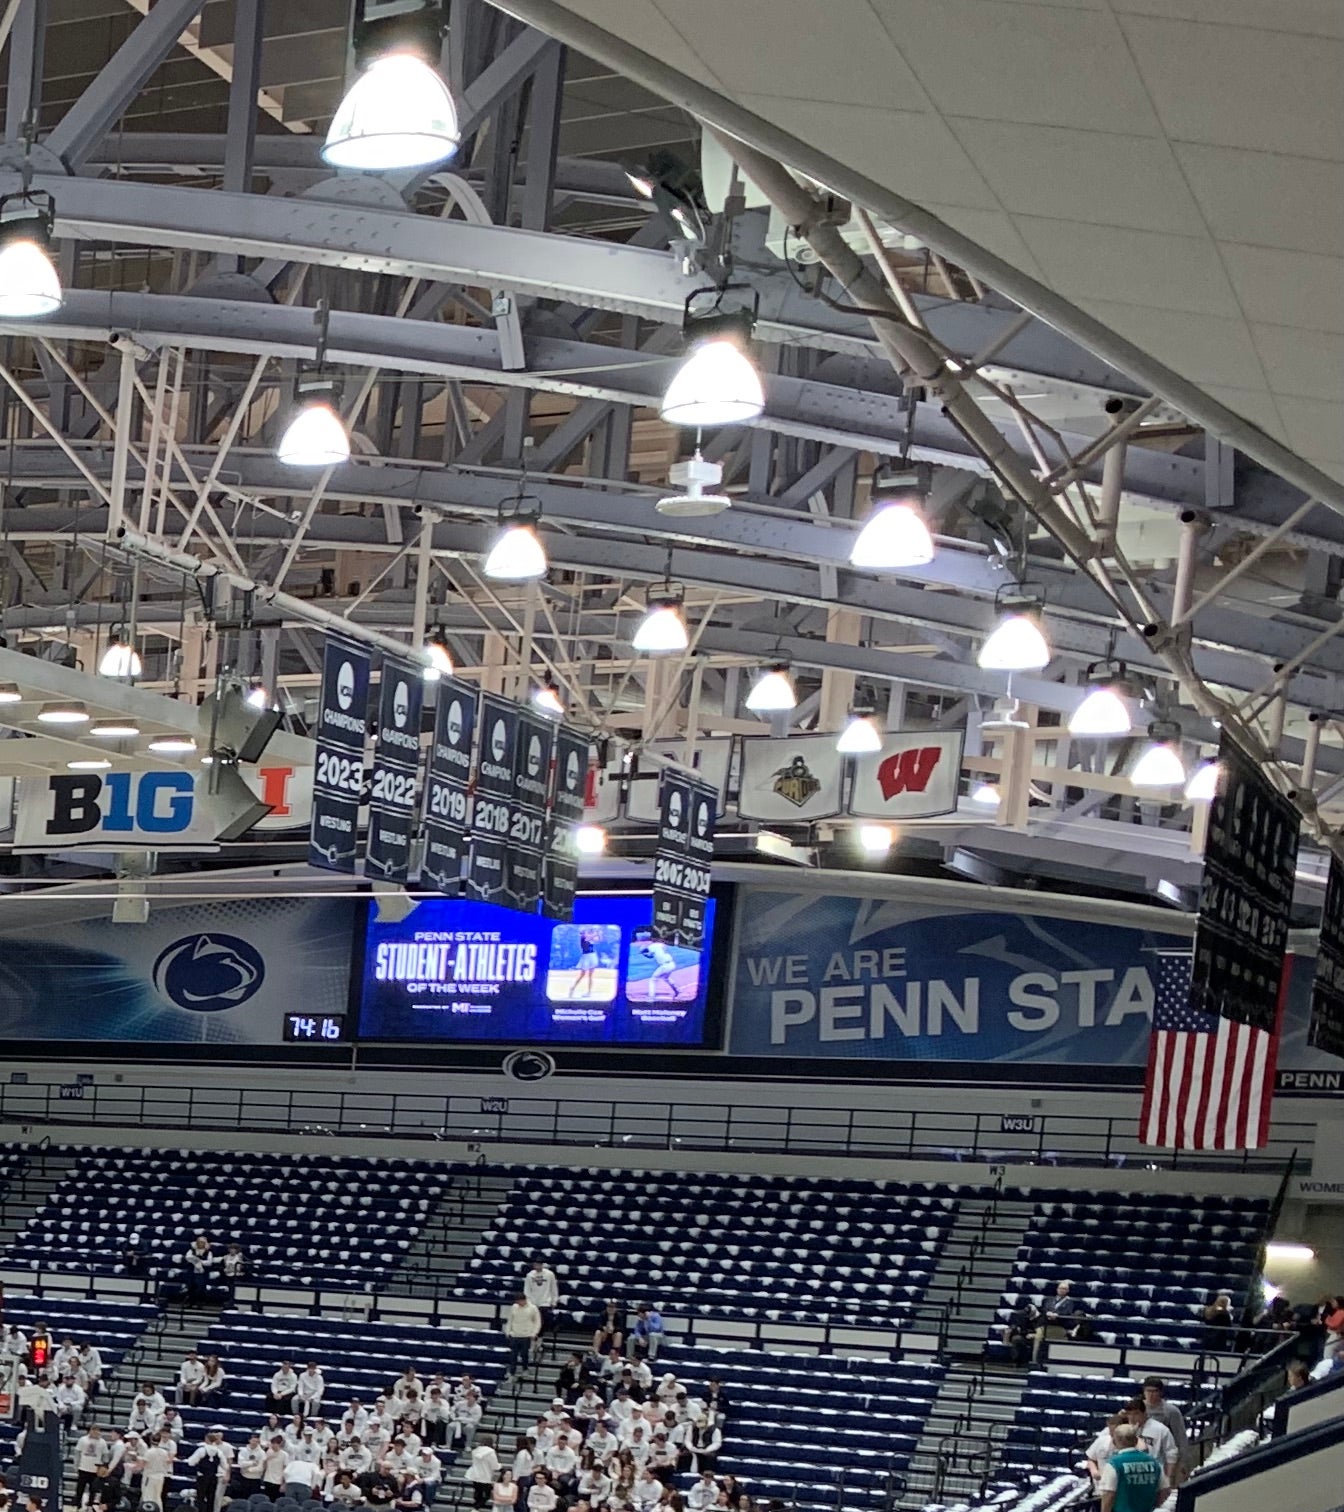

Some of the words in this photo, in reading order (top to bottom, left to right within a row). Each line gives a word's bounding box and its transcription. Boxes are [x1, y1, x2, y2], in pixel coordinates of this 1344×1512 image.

[317, 752, 363, 791] 2023
[372, 769, 415, 805] 2022
[877, 747, 942, 802] W
[432, 785, 466, 820] 2019
[475, 802, 509, 833] 2018
[511, 813, 542, 844] 2017
[415, 932, 453, 941] PENN
[456, 932, 500, 941] STATE
[376, 943, 537, 980] STUDENT-ATHLETES
[747, 955, 810, 986] WE
[823, 946, 907, 978] ARE
[407, 983, 426, 993] OF
[431, 984, 457, 993] THE
[459, 984, 500, 993] WEEK
[771, 977, 979, 1045] PENN
[1007, 966, 1155, 1030] STA
[290, 1017, 339, 1038] 74:16
[1281, 1072, 1339, 1087] PENN
[483, 1101, 507, 1111] W2U
[1004, 1119, 1032, 1130] W3U
